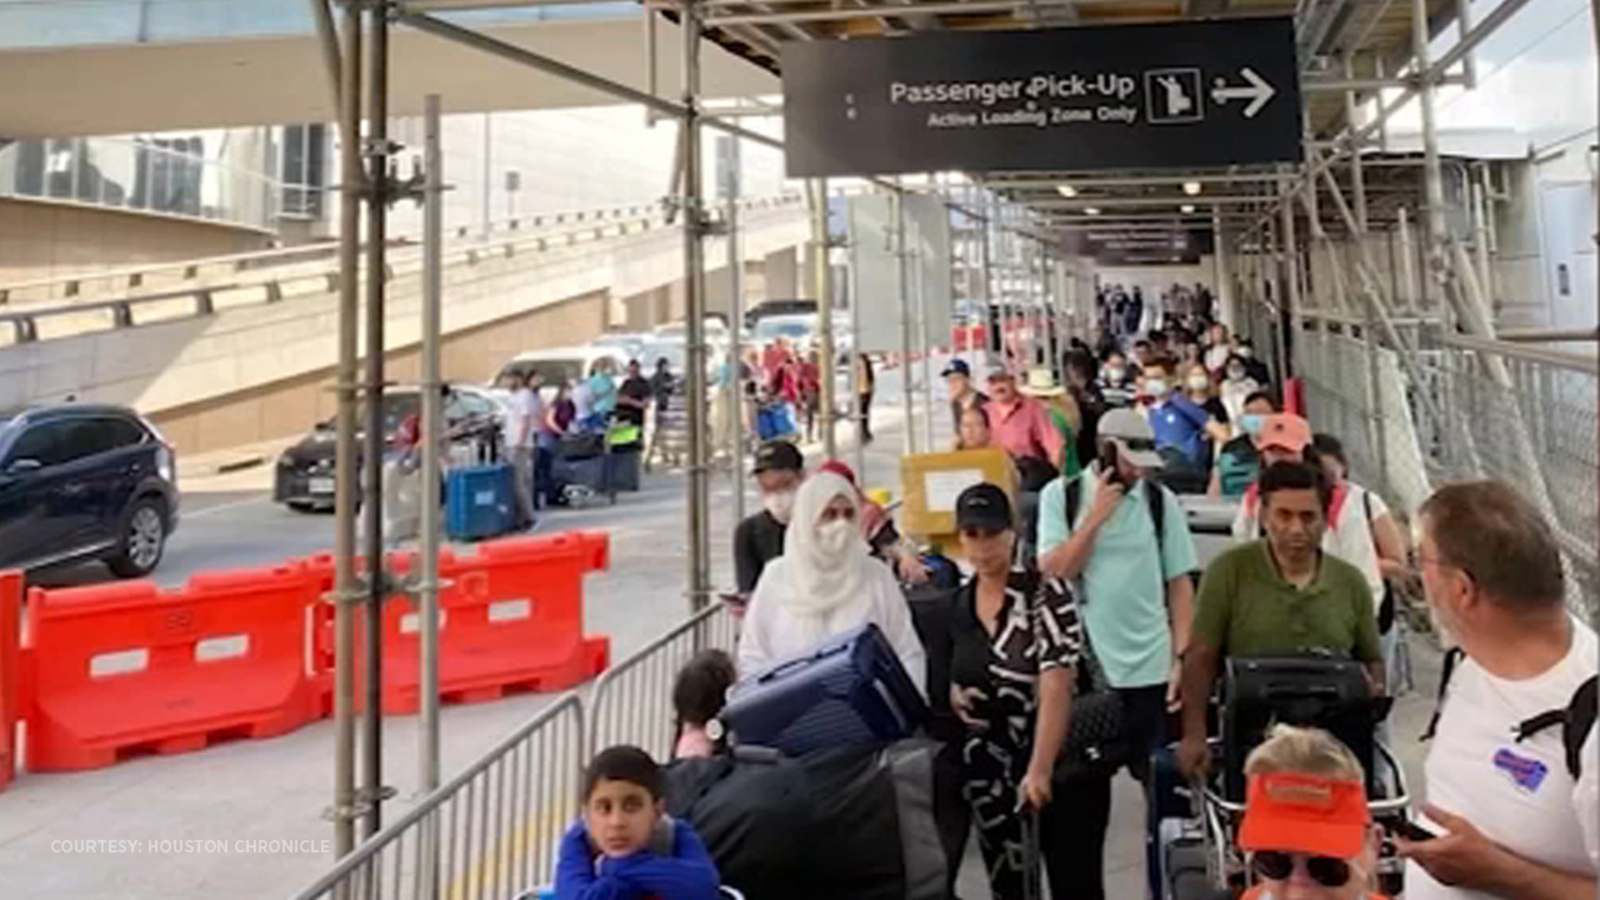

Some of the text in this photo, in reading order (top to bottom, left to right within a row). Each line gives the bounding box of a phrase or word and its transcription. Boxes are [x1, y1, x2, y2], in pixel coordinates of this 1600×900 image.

[891, 74, 1135, 105] Passenger Pick-Up
[927, 104, 1137, 127] Active Loading Zone Only
